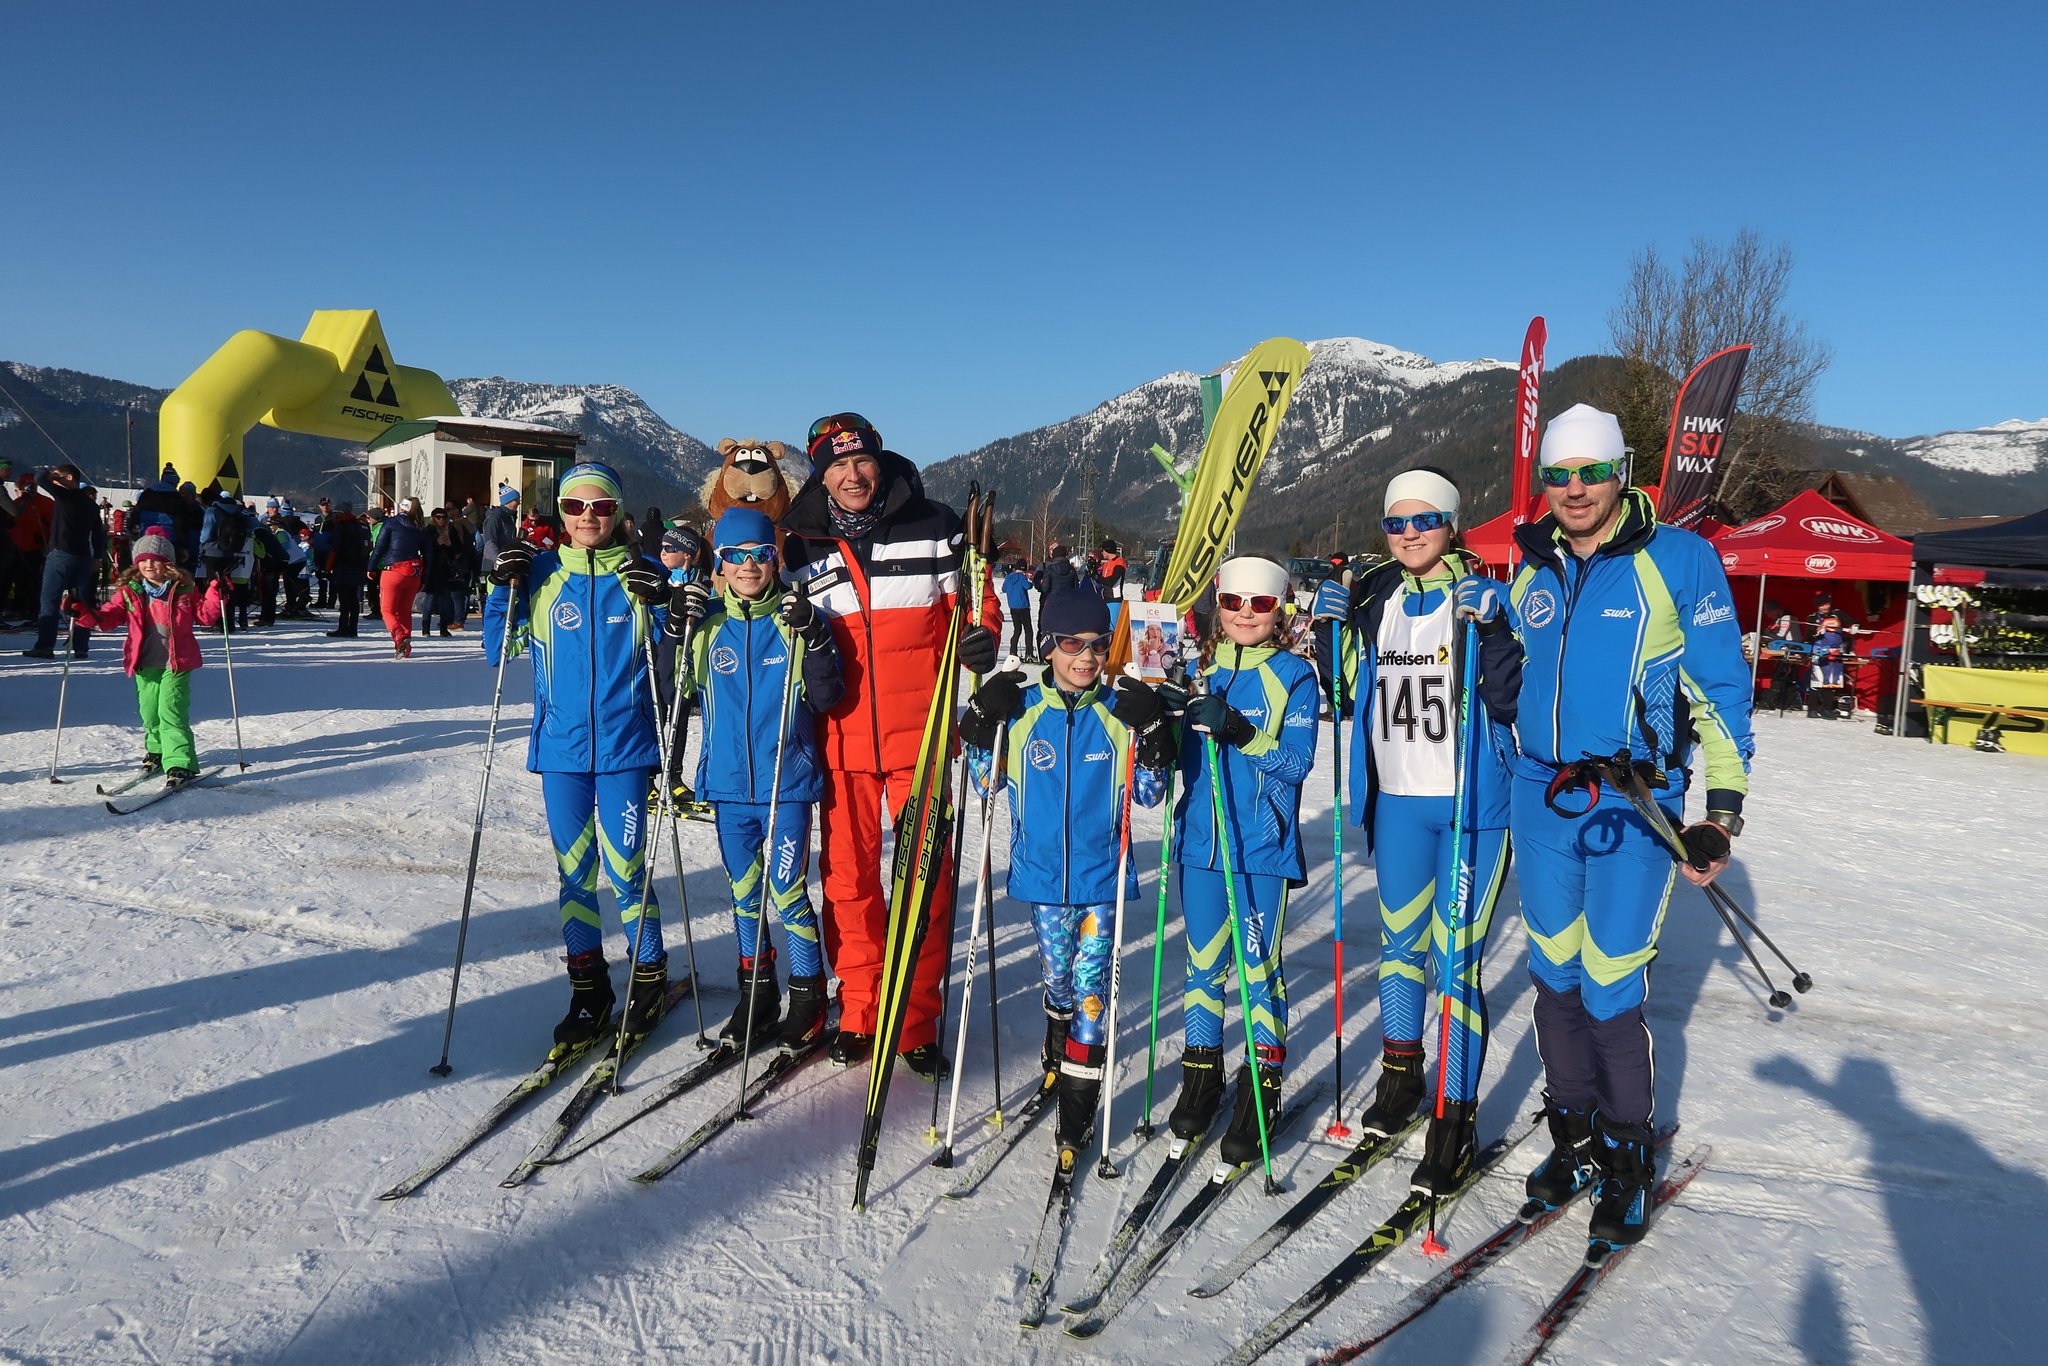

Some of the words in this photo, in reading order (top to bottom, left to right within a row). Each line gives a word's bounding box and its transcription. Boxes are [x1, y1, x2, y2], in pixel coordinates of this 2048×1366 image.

[1682, 415, 1726, 433] HWK
[832, 443, 848, 455] Red
[847, 439, 864, 451] Bull
[1680, 432, 1722, 456] SKI
[1677, 455, 1716, 474] WAX
[1810, 520, 1869, 539] HWK
[1808, 558, 1833, 569] HWK
[1376, 650, 1435, 666] aiffeisen
[1375, 675, 1449, 744] 145
[897, 795, 918, 881] FISCHER
[917, 796, 939, 882] FISCHER
[1180, 1060, 1214, 1070] FISCHER
